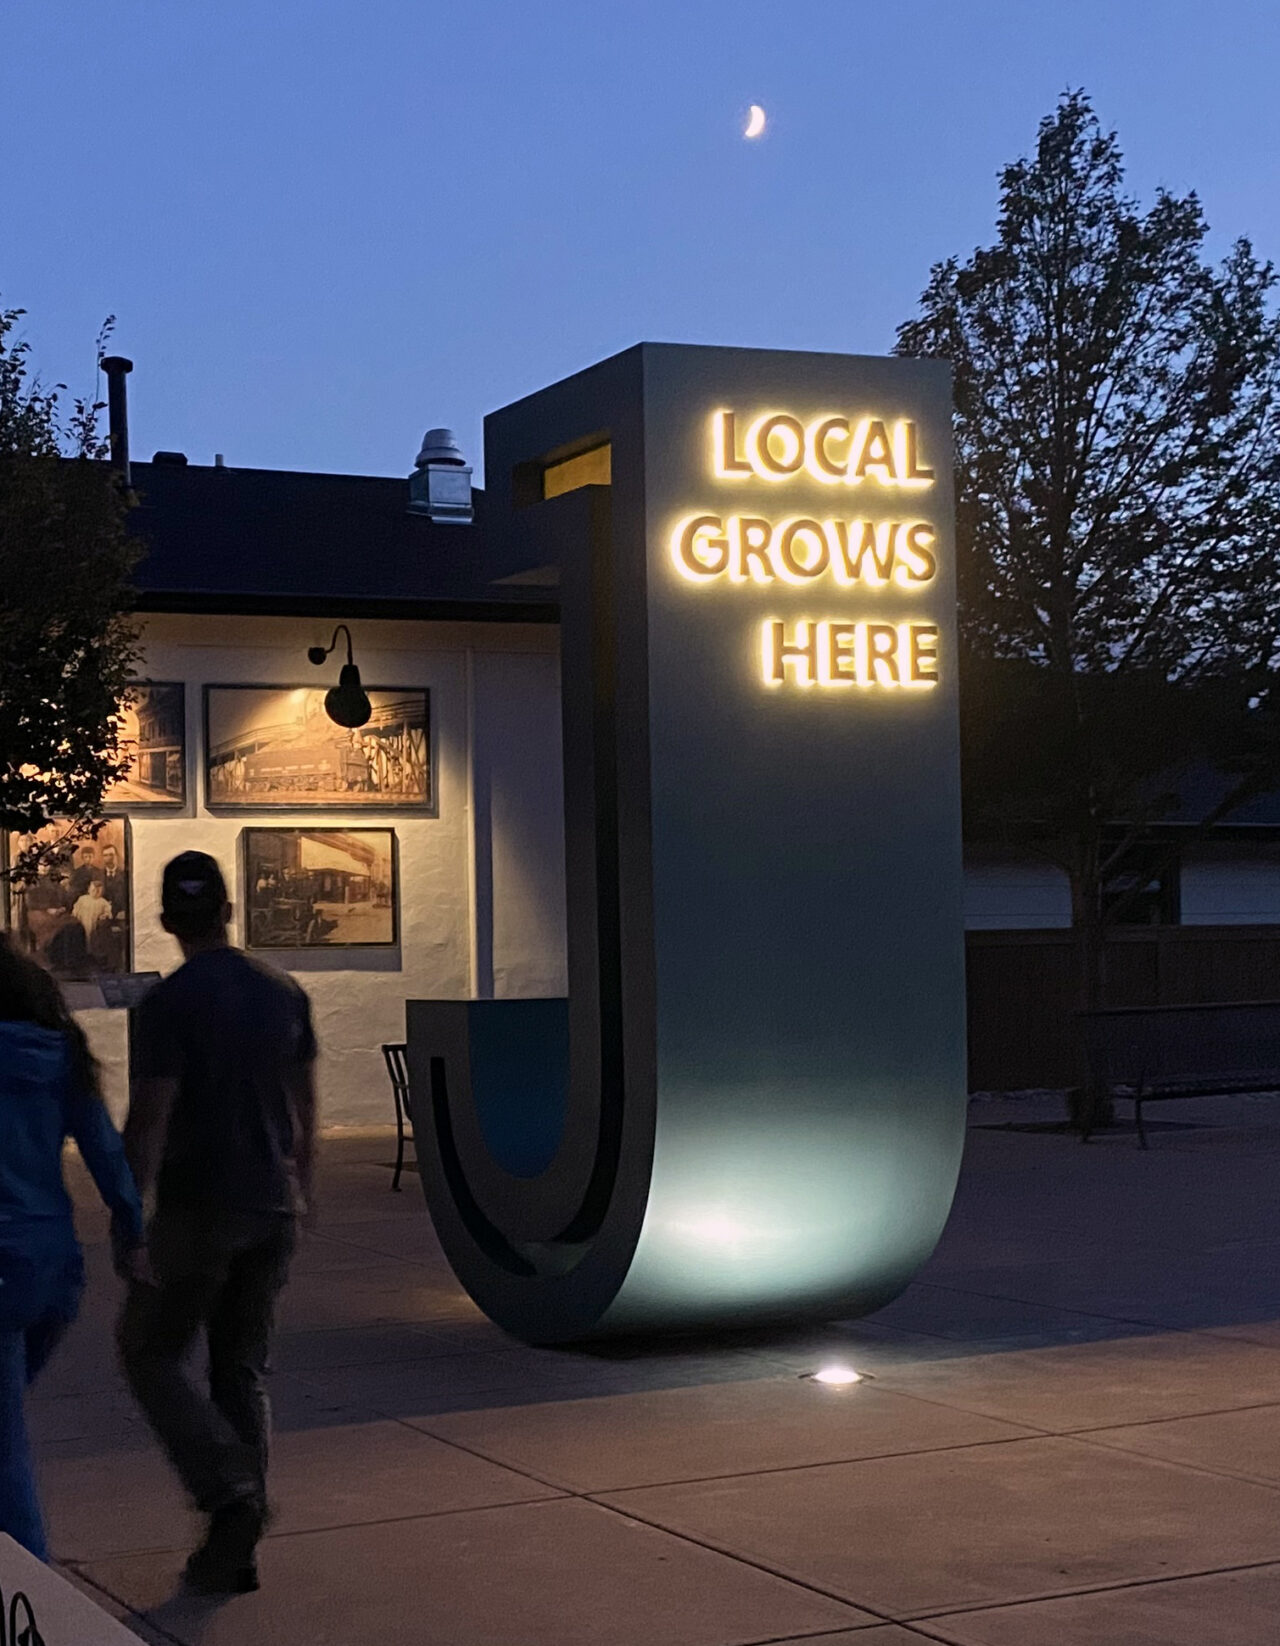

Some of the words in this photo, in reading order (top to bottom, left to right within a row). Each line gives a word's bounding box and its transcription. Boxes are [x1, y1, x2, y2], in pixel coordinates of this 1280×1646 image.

[716, 410, 935, 486] LOCAL
[673, 515, 937, 586] GROWS
[763, 620, 939, 686] HERE
